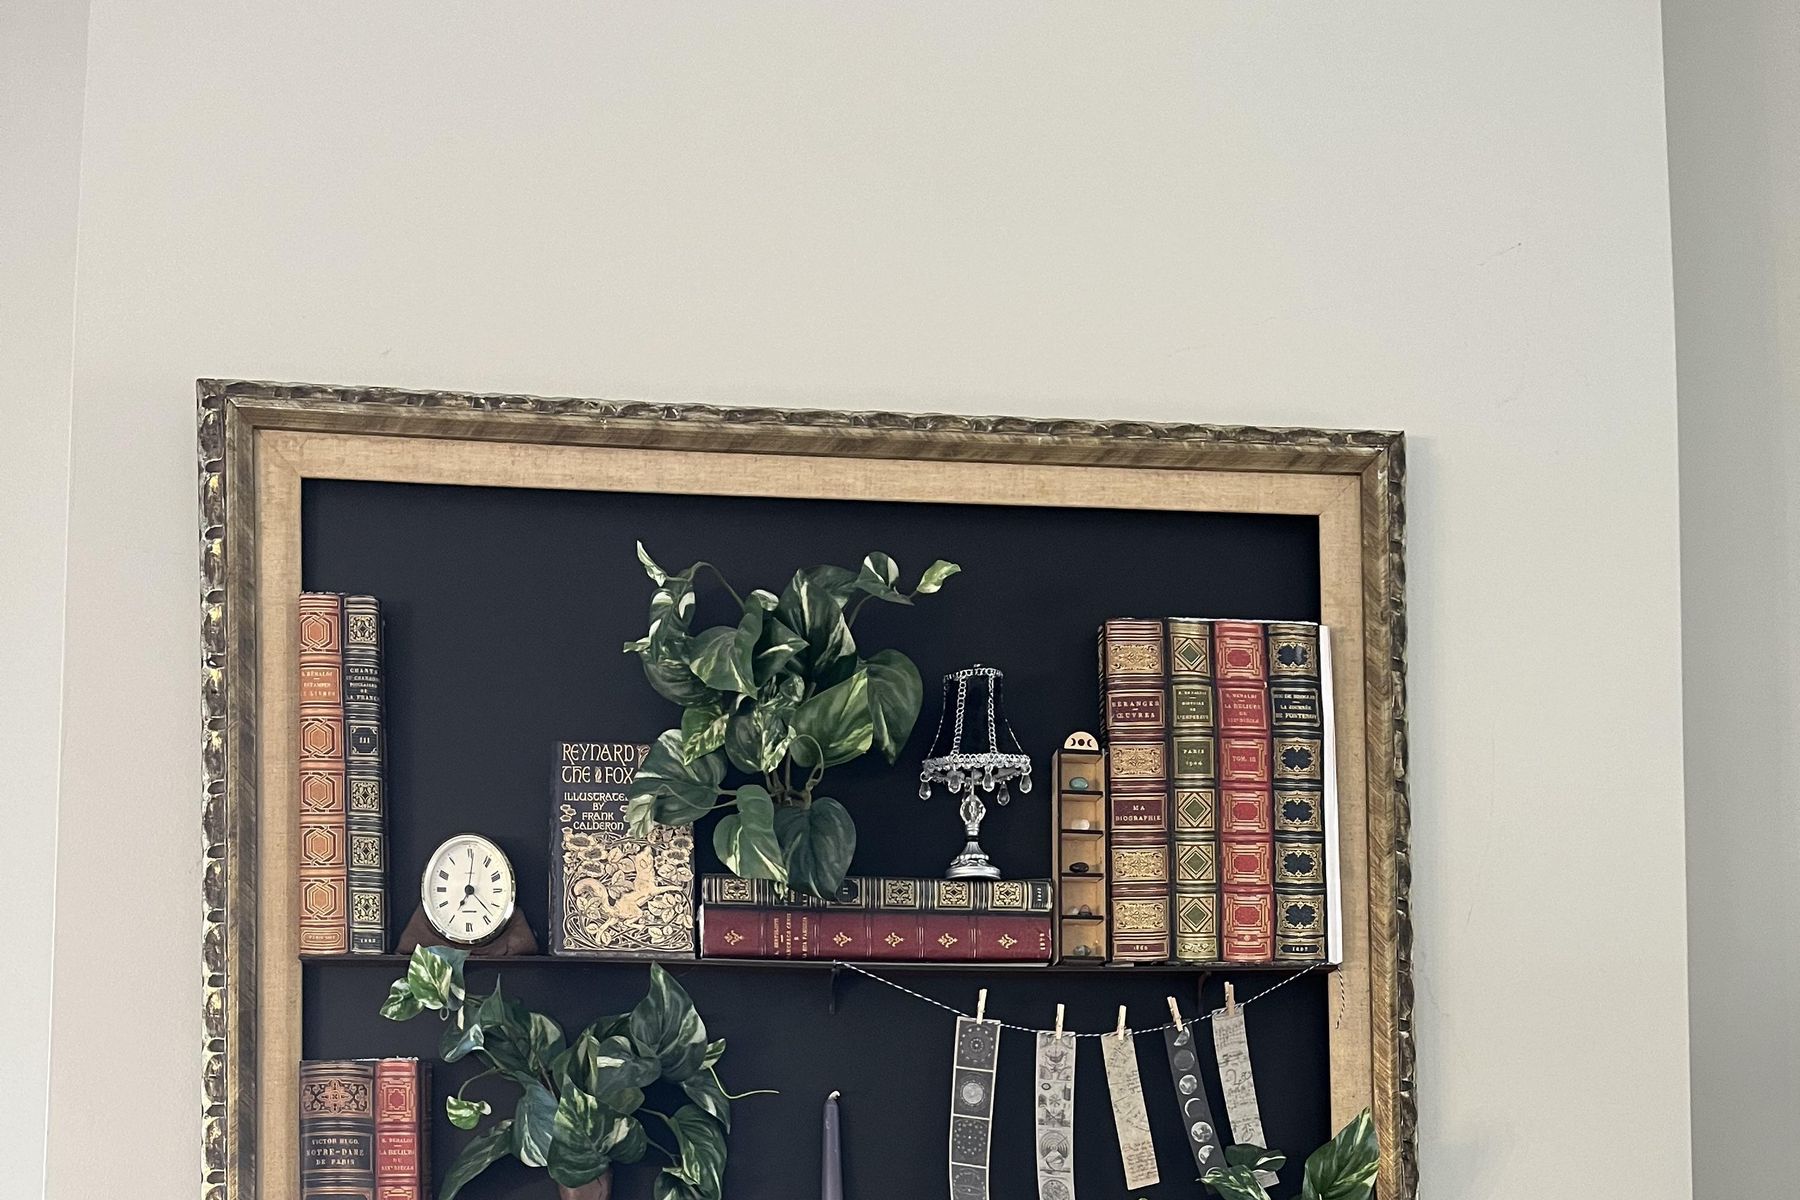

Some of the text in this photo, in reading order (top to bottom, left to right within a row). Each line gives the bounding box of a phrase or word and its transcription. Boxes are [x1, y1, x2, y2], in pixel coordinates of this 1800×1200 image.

[562, 743, 635, 766] REYNARD
[562, 766, 634, 784] THE FOX
[564, 792, 628, 802] ILLUSTRATE
[592, 802, 605, 811] BY
[582, 812, 614, 823] FRANK
[573, 822, 624, 832] CALDERON
